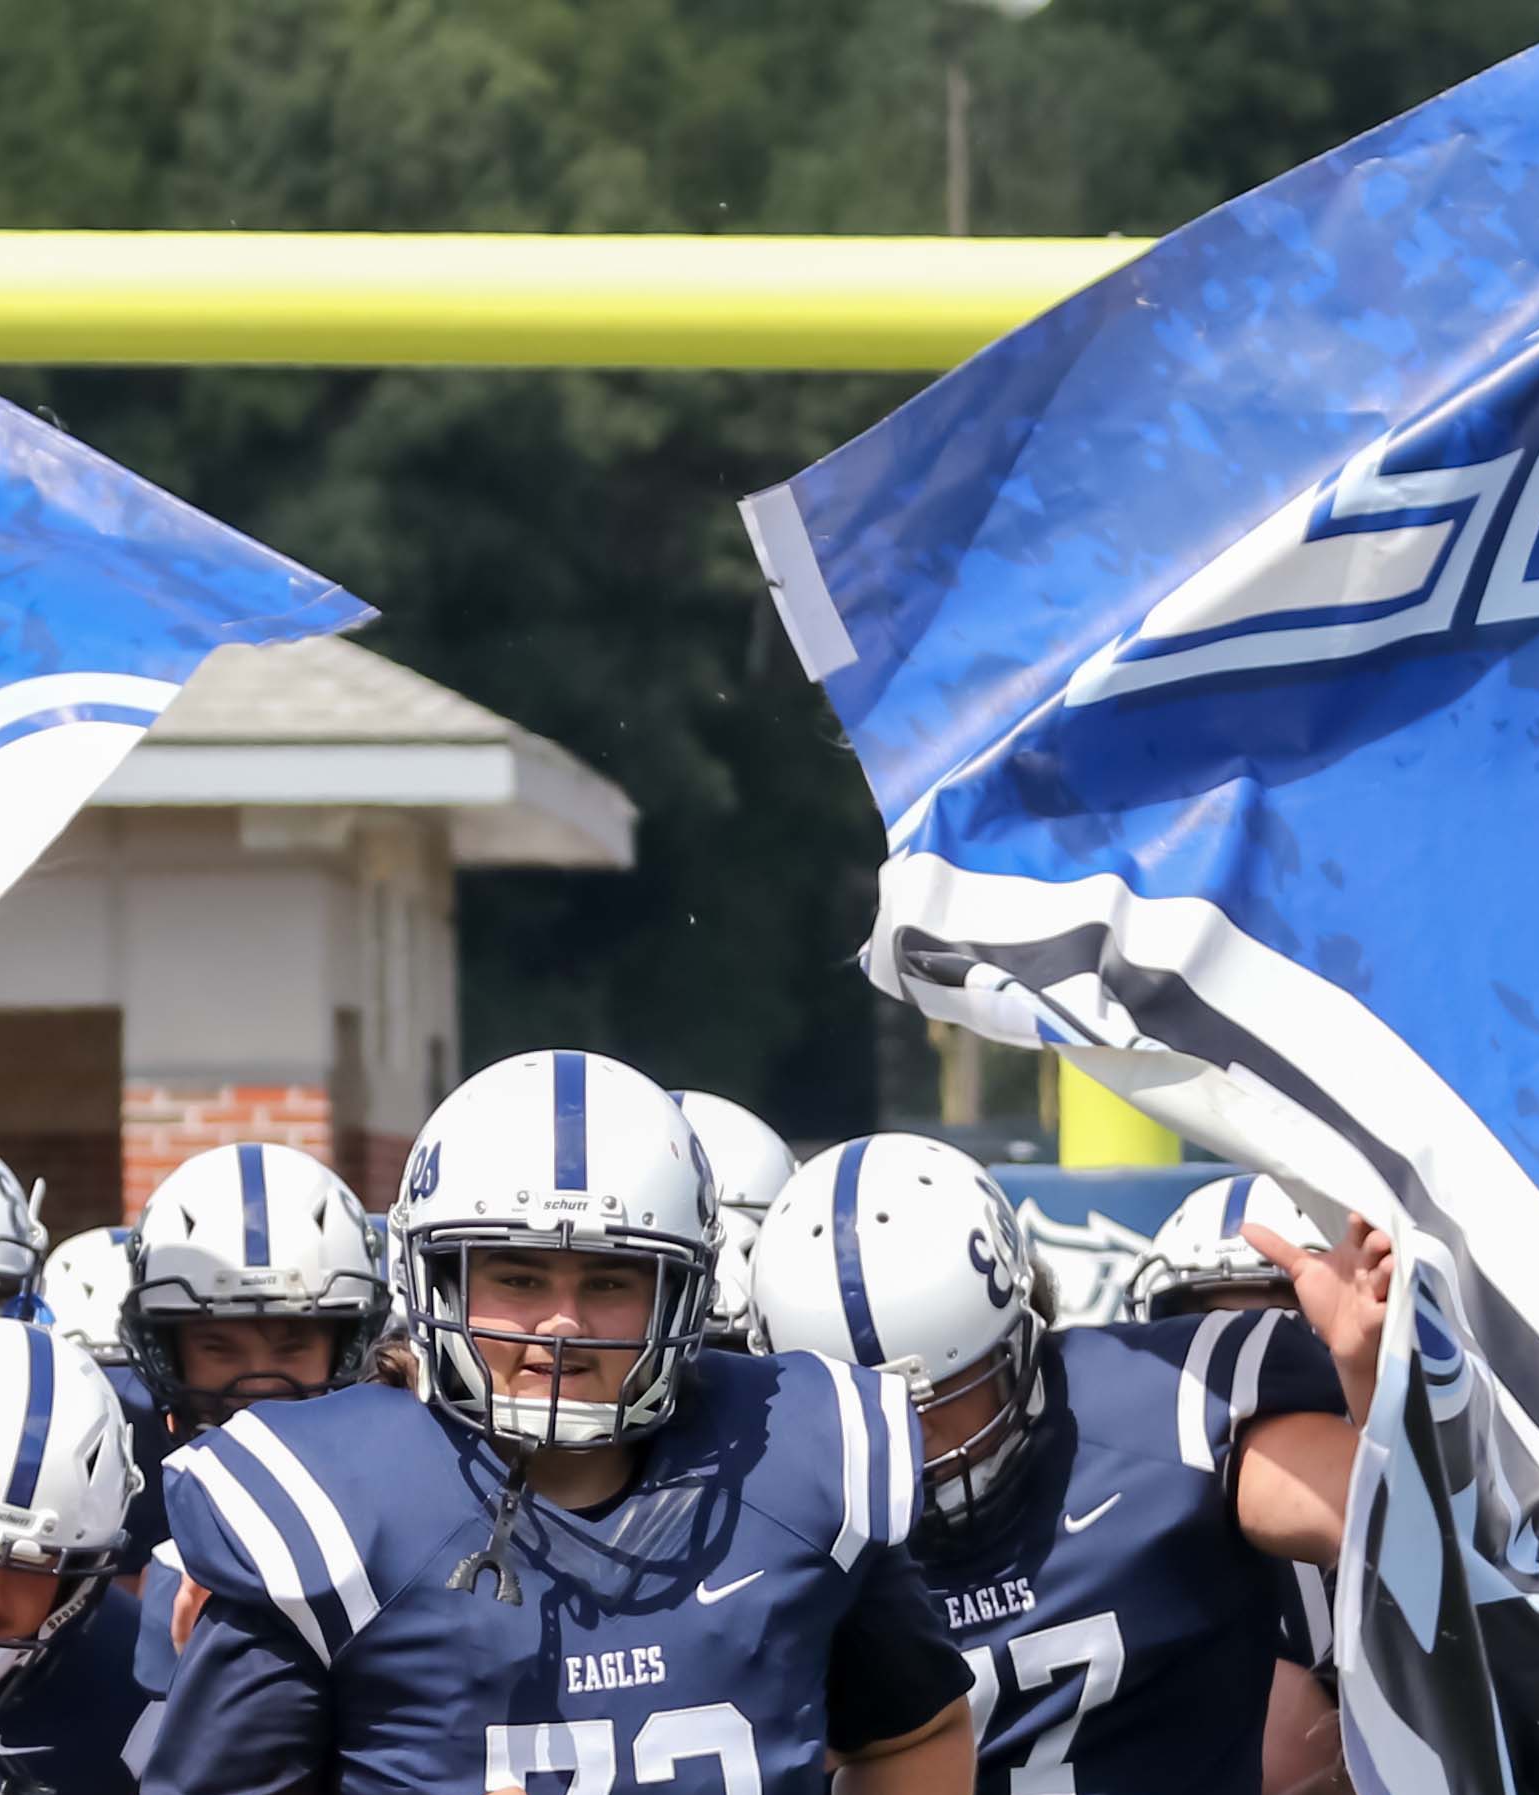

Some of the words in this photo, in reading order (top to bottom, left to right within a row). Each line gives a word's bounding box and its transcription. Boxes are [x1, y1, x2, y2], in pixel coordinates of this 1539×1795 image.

[543, 1199, 589, 1212] schutt
[944, 1576, 1037, 1630] EAGLES
[564, 1645, 667, 1694] EAGLES
